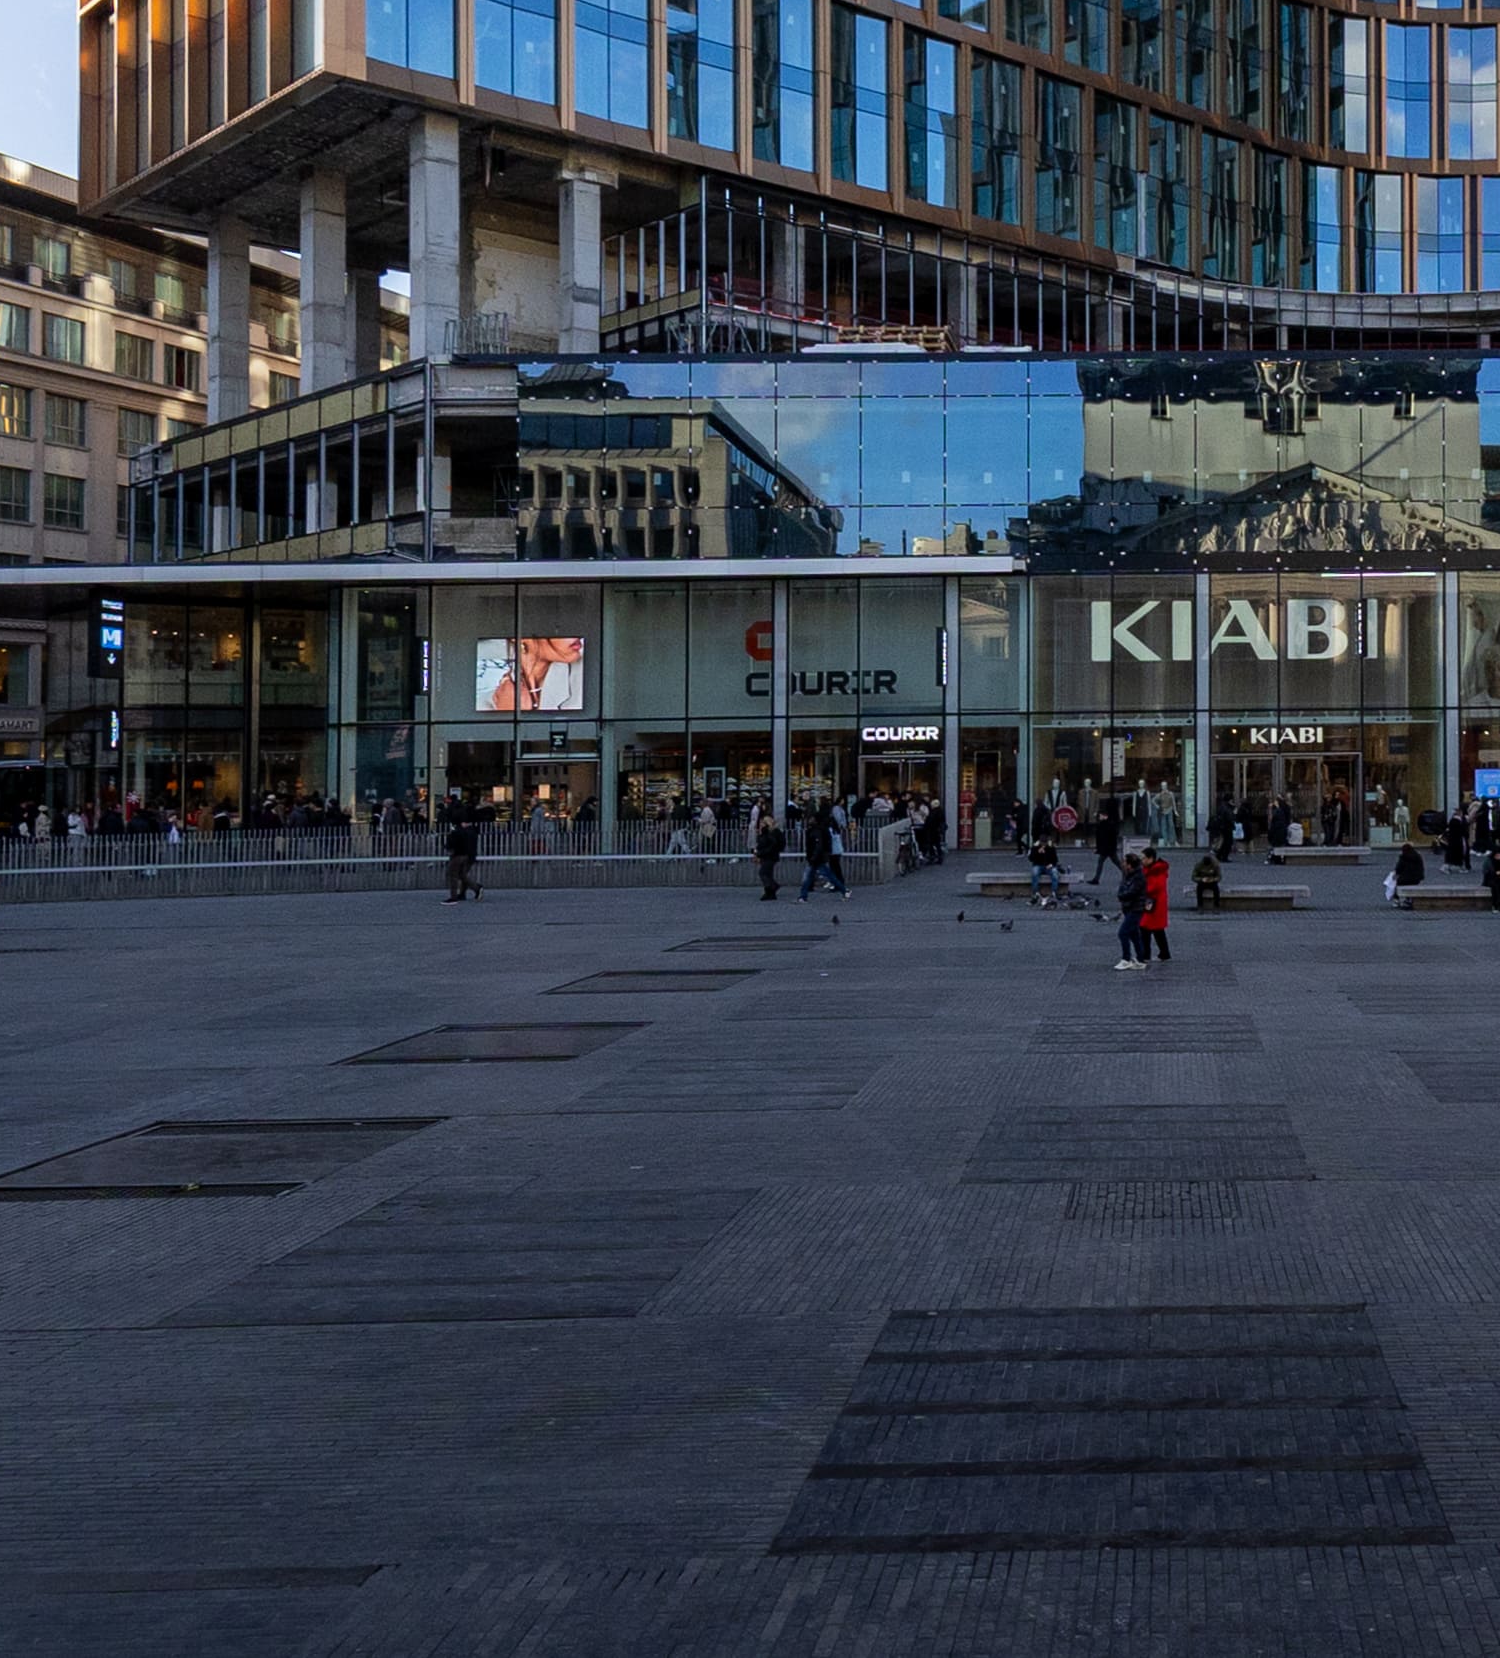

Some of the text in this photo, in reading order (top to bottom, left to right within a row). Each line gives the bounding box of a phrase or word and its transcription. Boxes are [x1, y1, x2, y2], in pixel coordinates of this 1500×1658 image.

[1090, 598, 1378, 662] KIABI
[746, 670, 897, 696] CURIR
[862, 726, 940, 742] COURIR
[1251, 727, 1323, 744] KIABI
